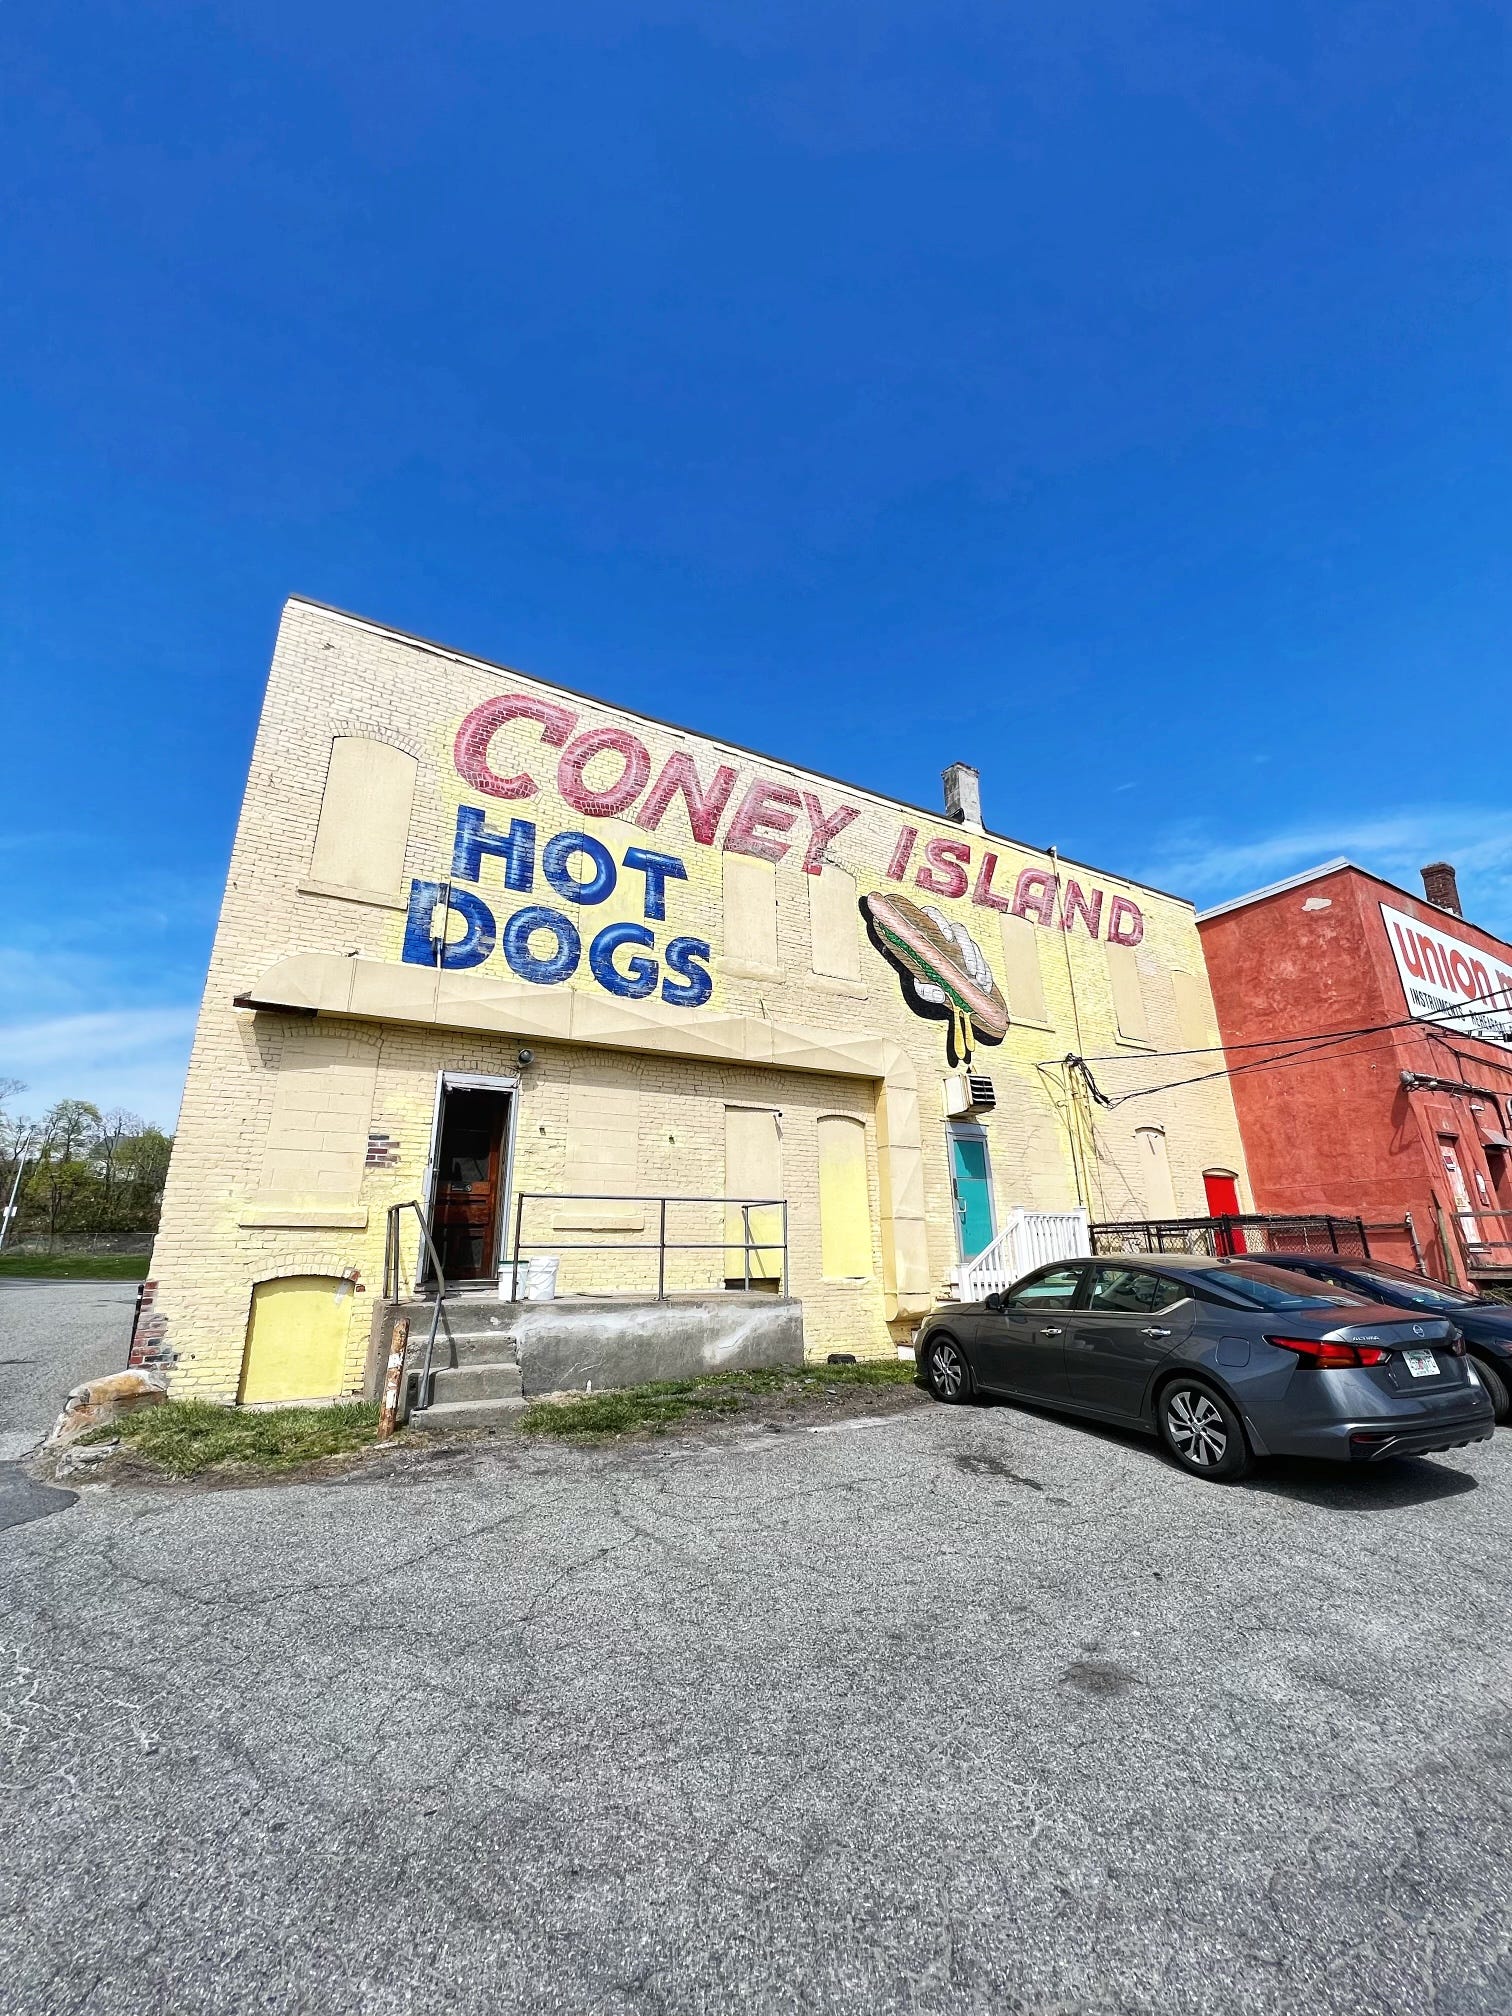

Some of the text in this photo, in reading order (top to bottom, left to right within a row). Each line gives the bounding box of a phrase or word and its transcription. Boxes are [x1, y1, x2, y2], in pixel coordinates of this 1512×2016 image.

[451, 804, 688, 921] HOT
[453, 693, 1144, 947] CONEY ISLAND
[402, 878, 713, 1008] DOGS
